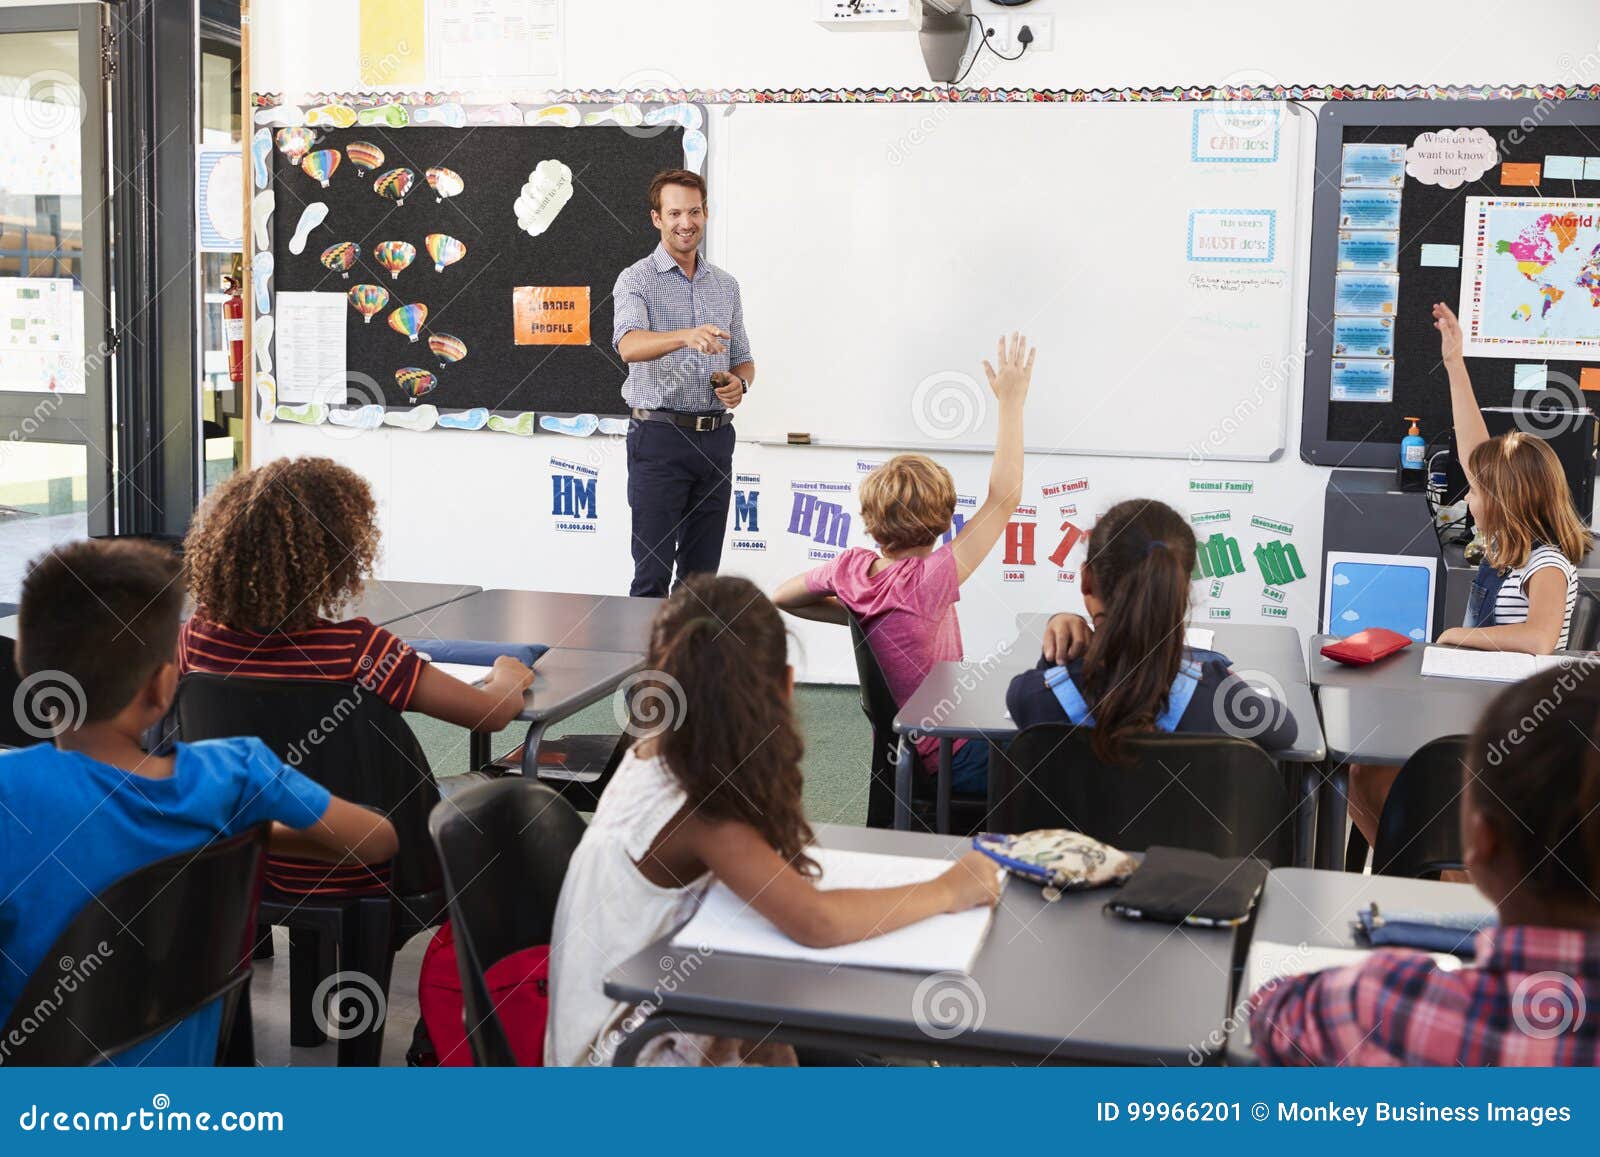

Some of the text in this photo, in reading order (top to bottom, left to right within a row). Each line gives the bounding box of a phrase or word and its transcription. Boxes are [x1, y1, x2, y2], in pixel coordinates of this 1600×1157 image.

[1453, 135, 1464, 144] do
[1418, 150, 1485, 160] want to know
[1433, 166, 1467, 176] about?
[1549, 215, 1593, 228] World
[1199, 236, 1238, 250] MUST
[531, 322, 573, 334] PROFILE
[550, 458, 599, 476] Hundred Millions
[736, 475, 761, 483] Millions
[791, 482, 852, 491] Hundred Thousands
[1042, 480, 1088, 496] Unit Family
[1190, 481, 1253, 492] Decimal Family
[552, 475, 598, 519] HM
[734, 490, 760, 532] M
[787, 492, 852, 548] HTh
[1002, 522, 1037, 566] H
